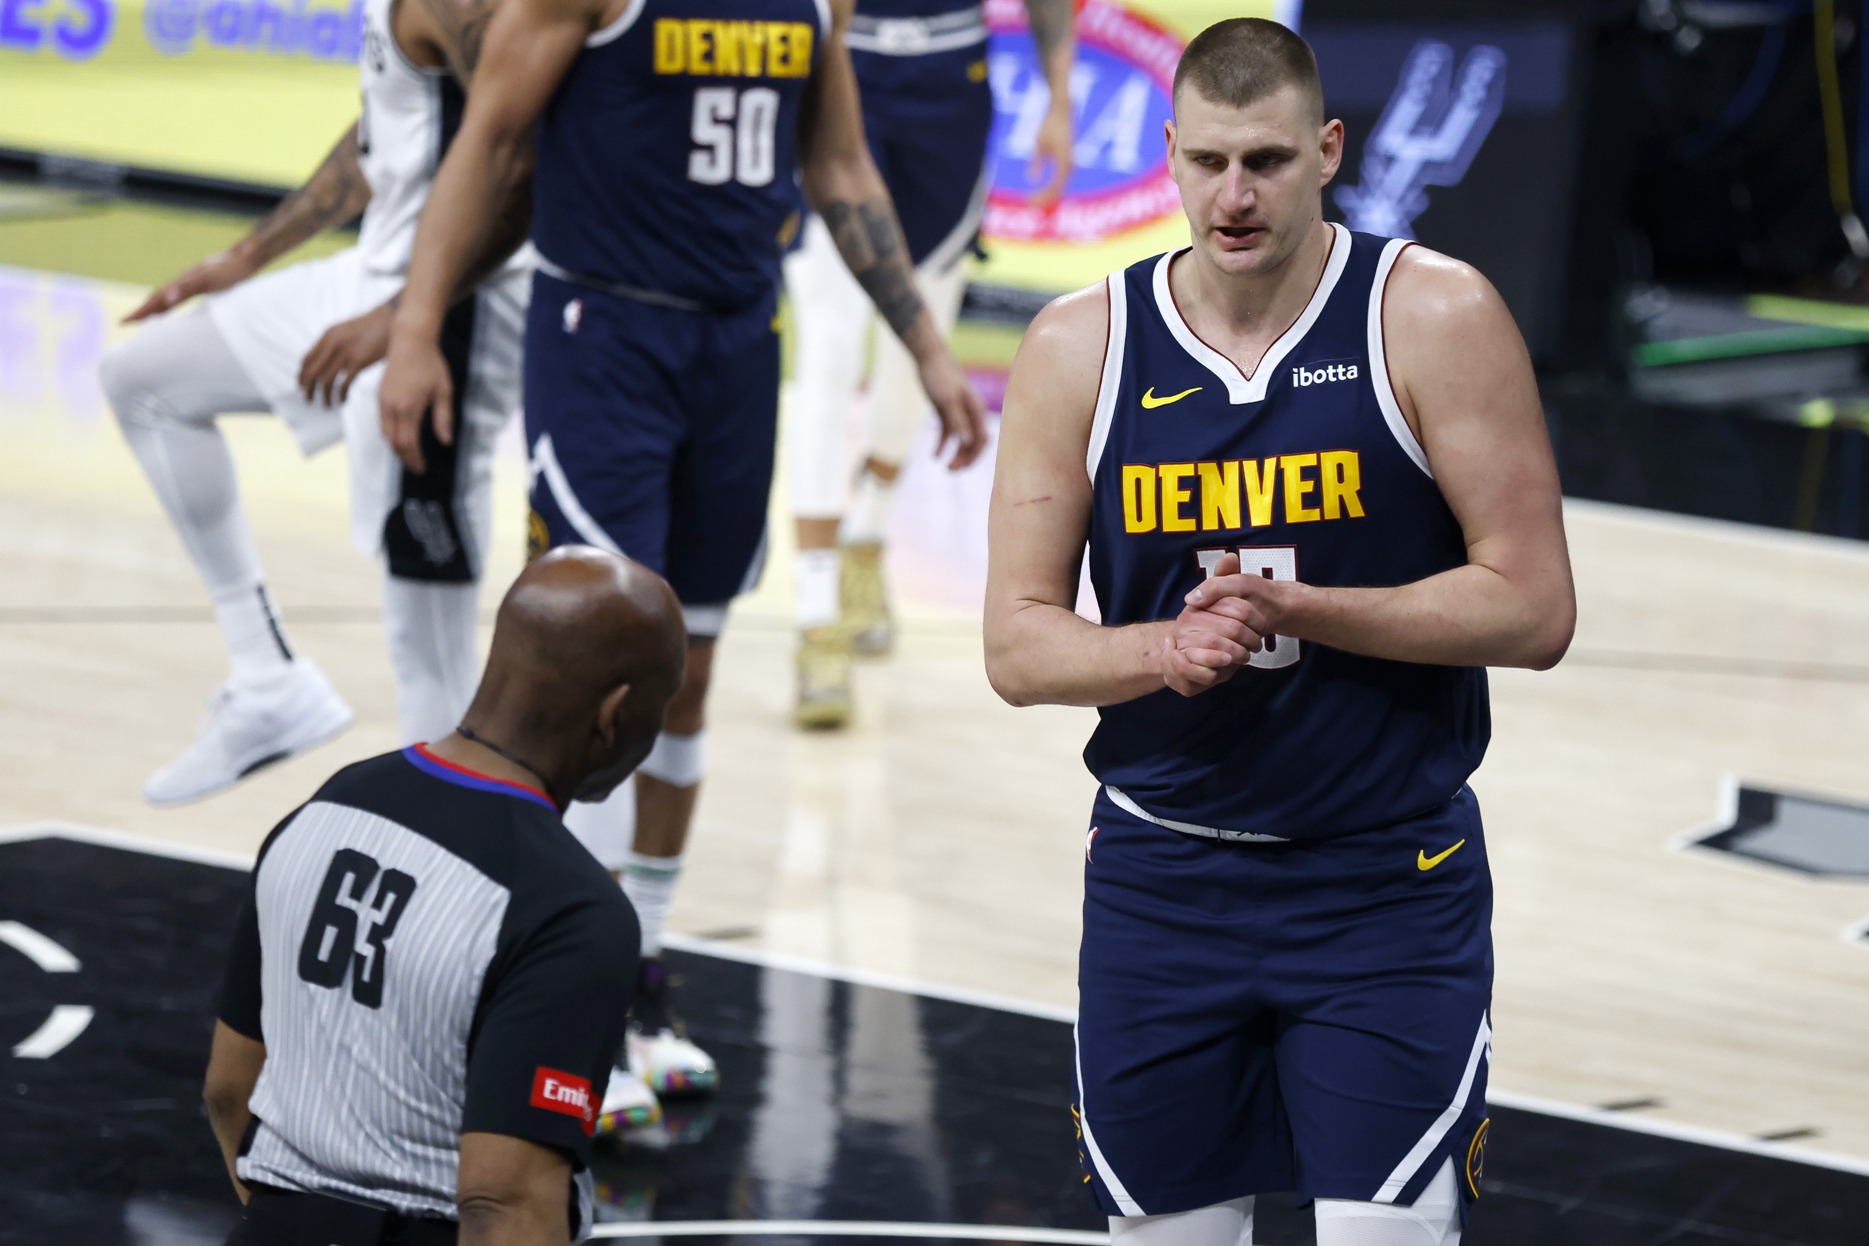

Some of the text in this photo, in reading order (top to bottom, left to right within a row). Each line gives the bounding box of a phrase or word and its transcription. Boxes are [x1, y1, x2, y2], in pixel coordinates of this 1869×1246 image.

[654, 17, 813, 79] DENVER
[688, 86, 780, 187] 50
[1292, 364, 1359, 388] ibotta
[1121, 450, 1366, 534] DENVER
[297, 848, 417, 1011] 63
